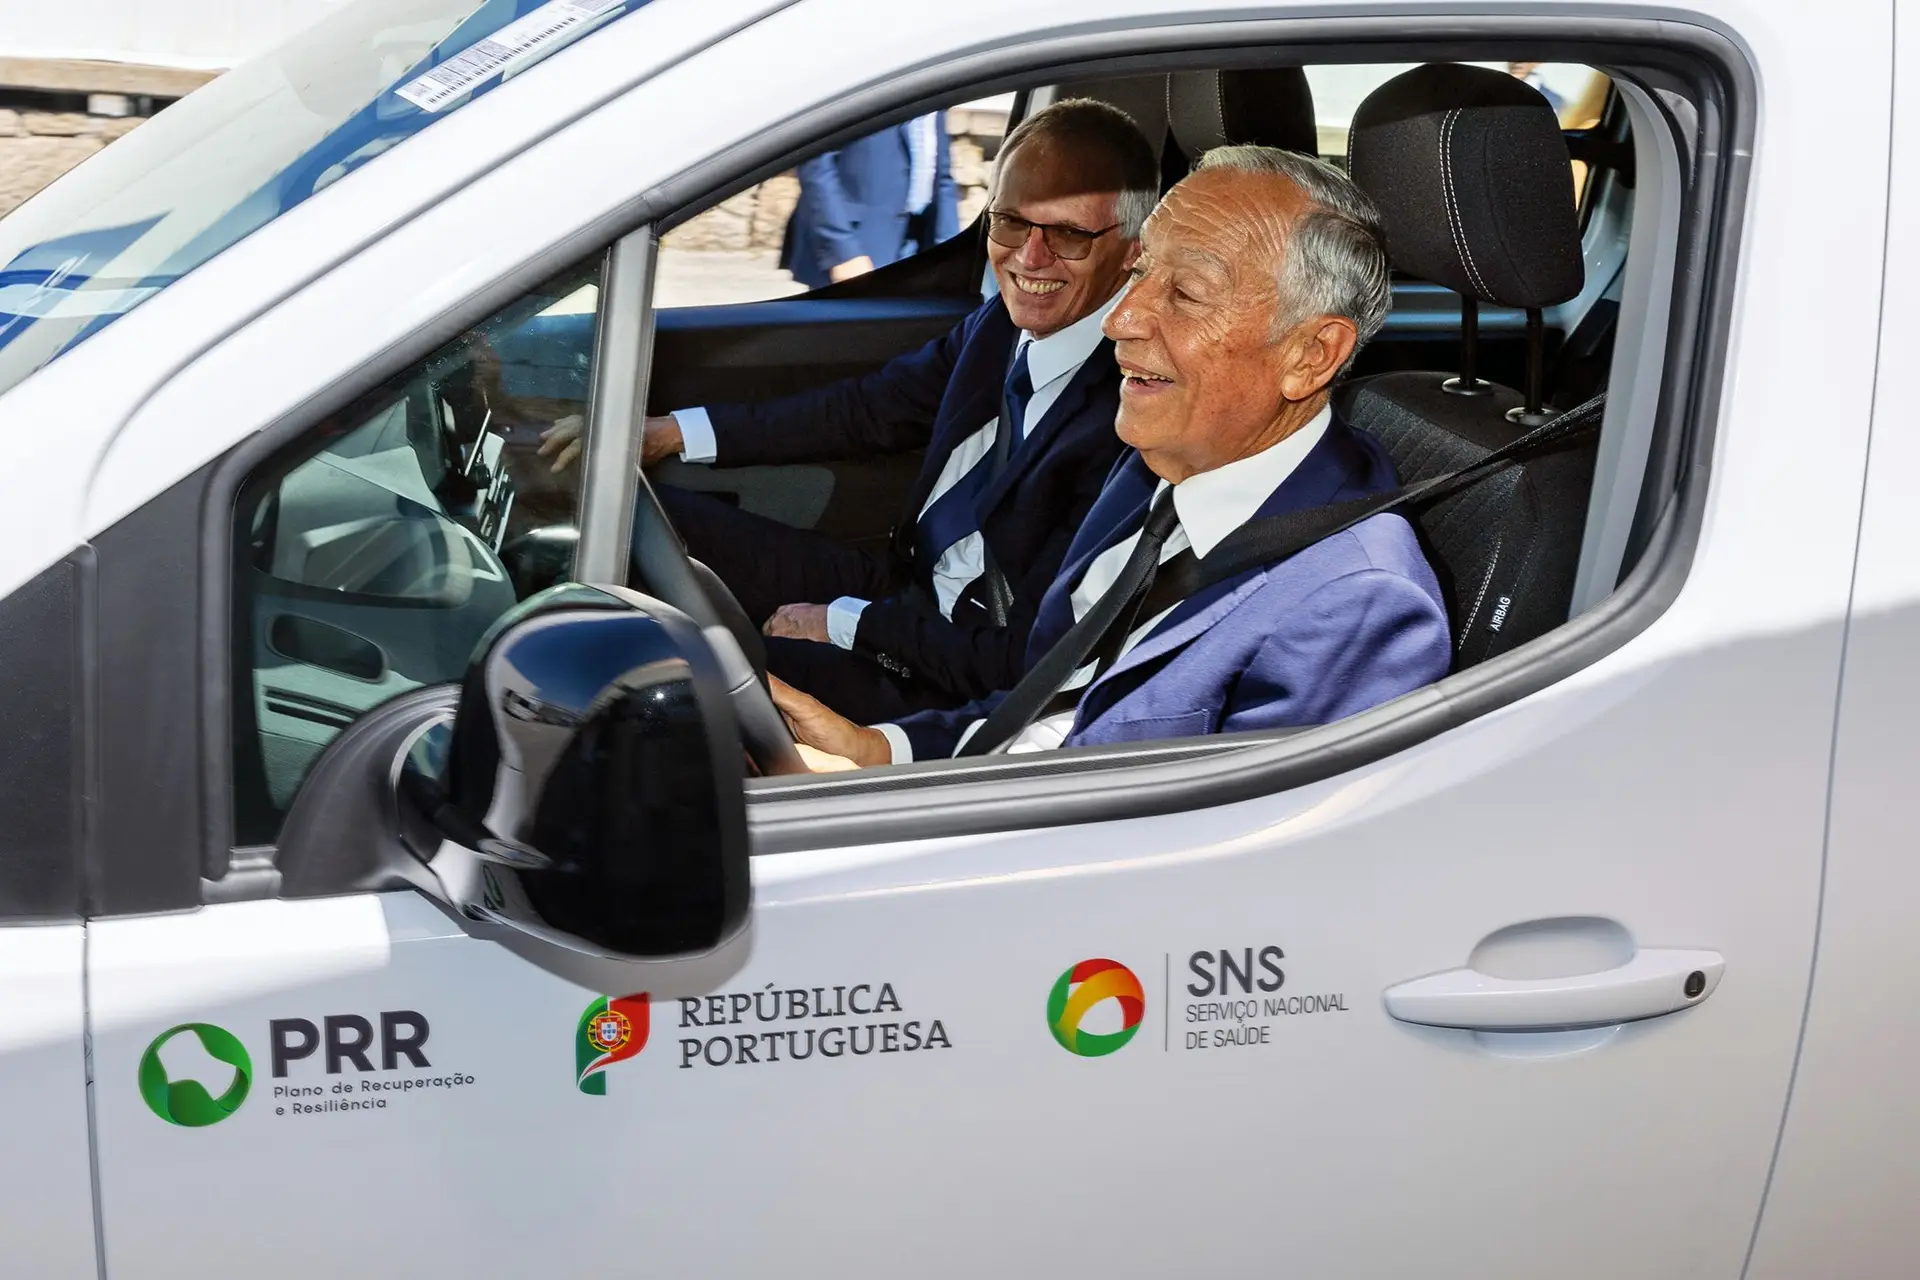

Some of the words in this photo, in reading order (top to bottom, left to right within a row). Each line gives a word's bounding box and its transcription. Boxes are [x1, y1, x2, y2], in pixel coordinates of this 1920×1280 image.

[1490, 596, 1511, 632] AIRBAG
[1186, 945, 1286, 997] SNS
[677, 982, 903, 1028] REPÚBLICA
[1185, 1000, 1258, 1023] SERVIÇO
[1264, 993, 1349, 1017] NACIONAL
[269, 1010, 432, 1078] PRR
[678, 1019, 953, 1069] PORTUGUESA
[1185, 1031, 1208, 1050] DE
[1213, 1023, 1271, 1048] SAÚDE
[273, 1086, 323, 1099] Plano
[331, 1081, 353, 1095] de
[361, 1072, 476, 1093] Recuperação
[275, 1105, 285, 1116] e
[293, 1097, 388, 1115] Resiliência
